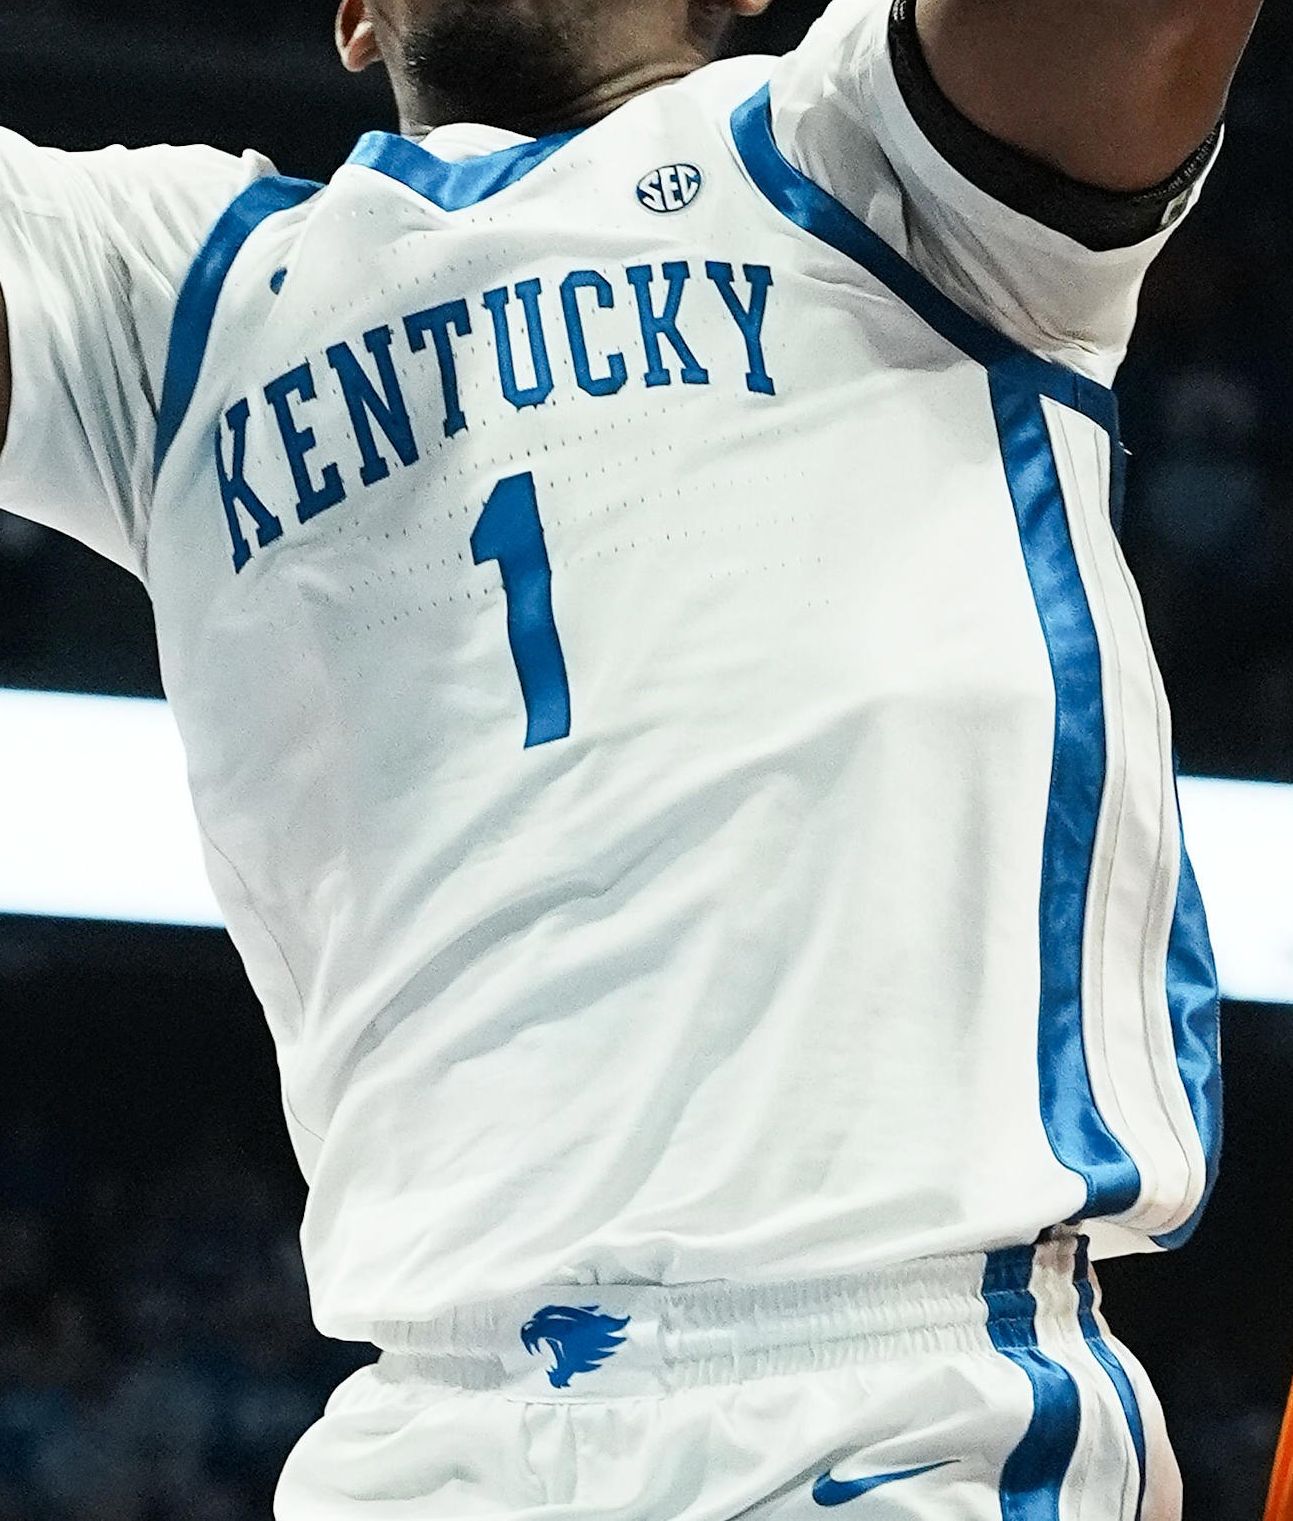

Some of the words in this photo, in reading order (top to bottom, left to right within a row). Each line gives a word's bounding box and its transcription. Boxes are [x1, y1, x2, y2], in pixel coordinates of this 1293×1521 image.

[638, 165, 700, 211] SEC
[214, 260, 776, 575] KENTUCKY
[470, 471, 572, 750] 1
